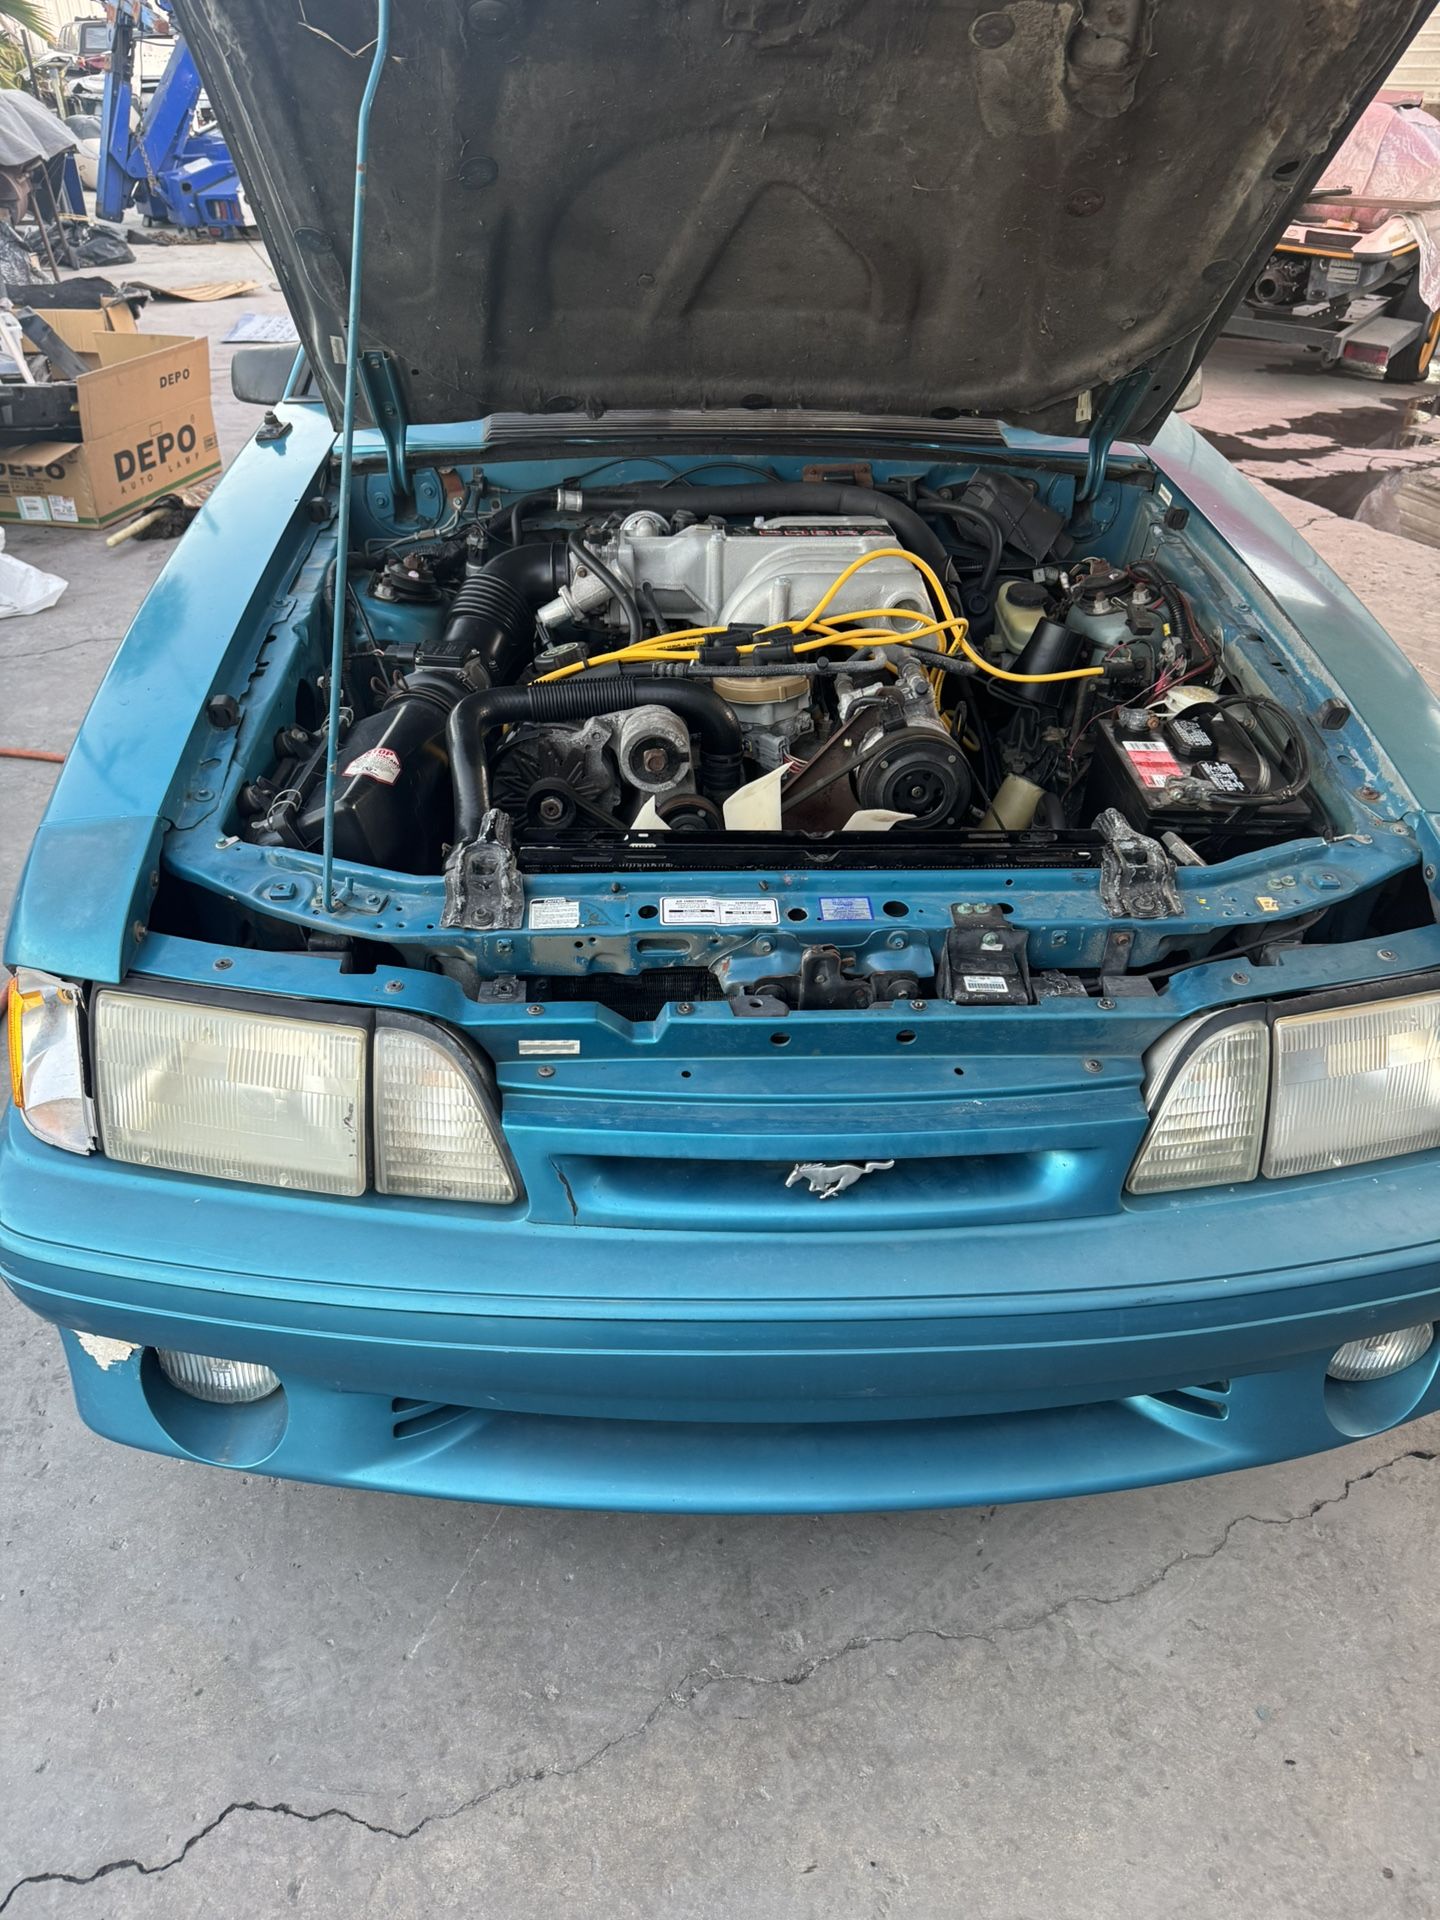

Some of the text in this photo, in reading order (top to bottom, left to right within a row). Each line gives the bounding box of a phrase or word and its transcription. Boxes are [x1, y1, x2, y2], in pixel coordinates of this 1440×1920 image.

[159, 368, 190, 388] DEPO
[114, 424, 196, 483] DEPO
[121, 452, 199, 494] AUTO LAMP
